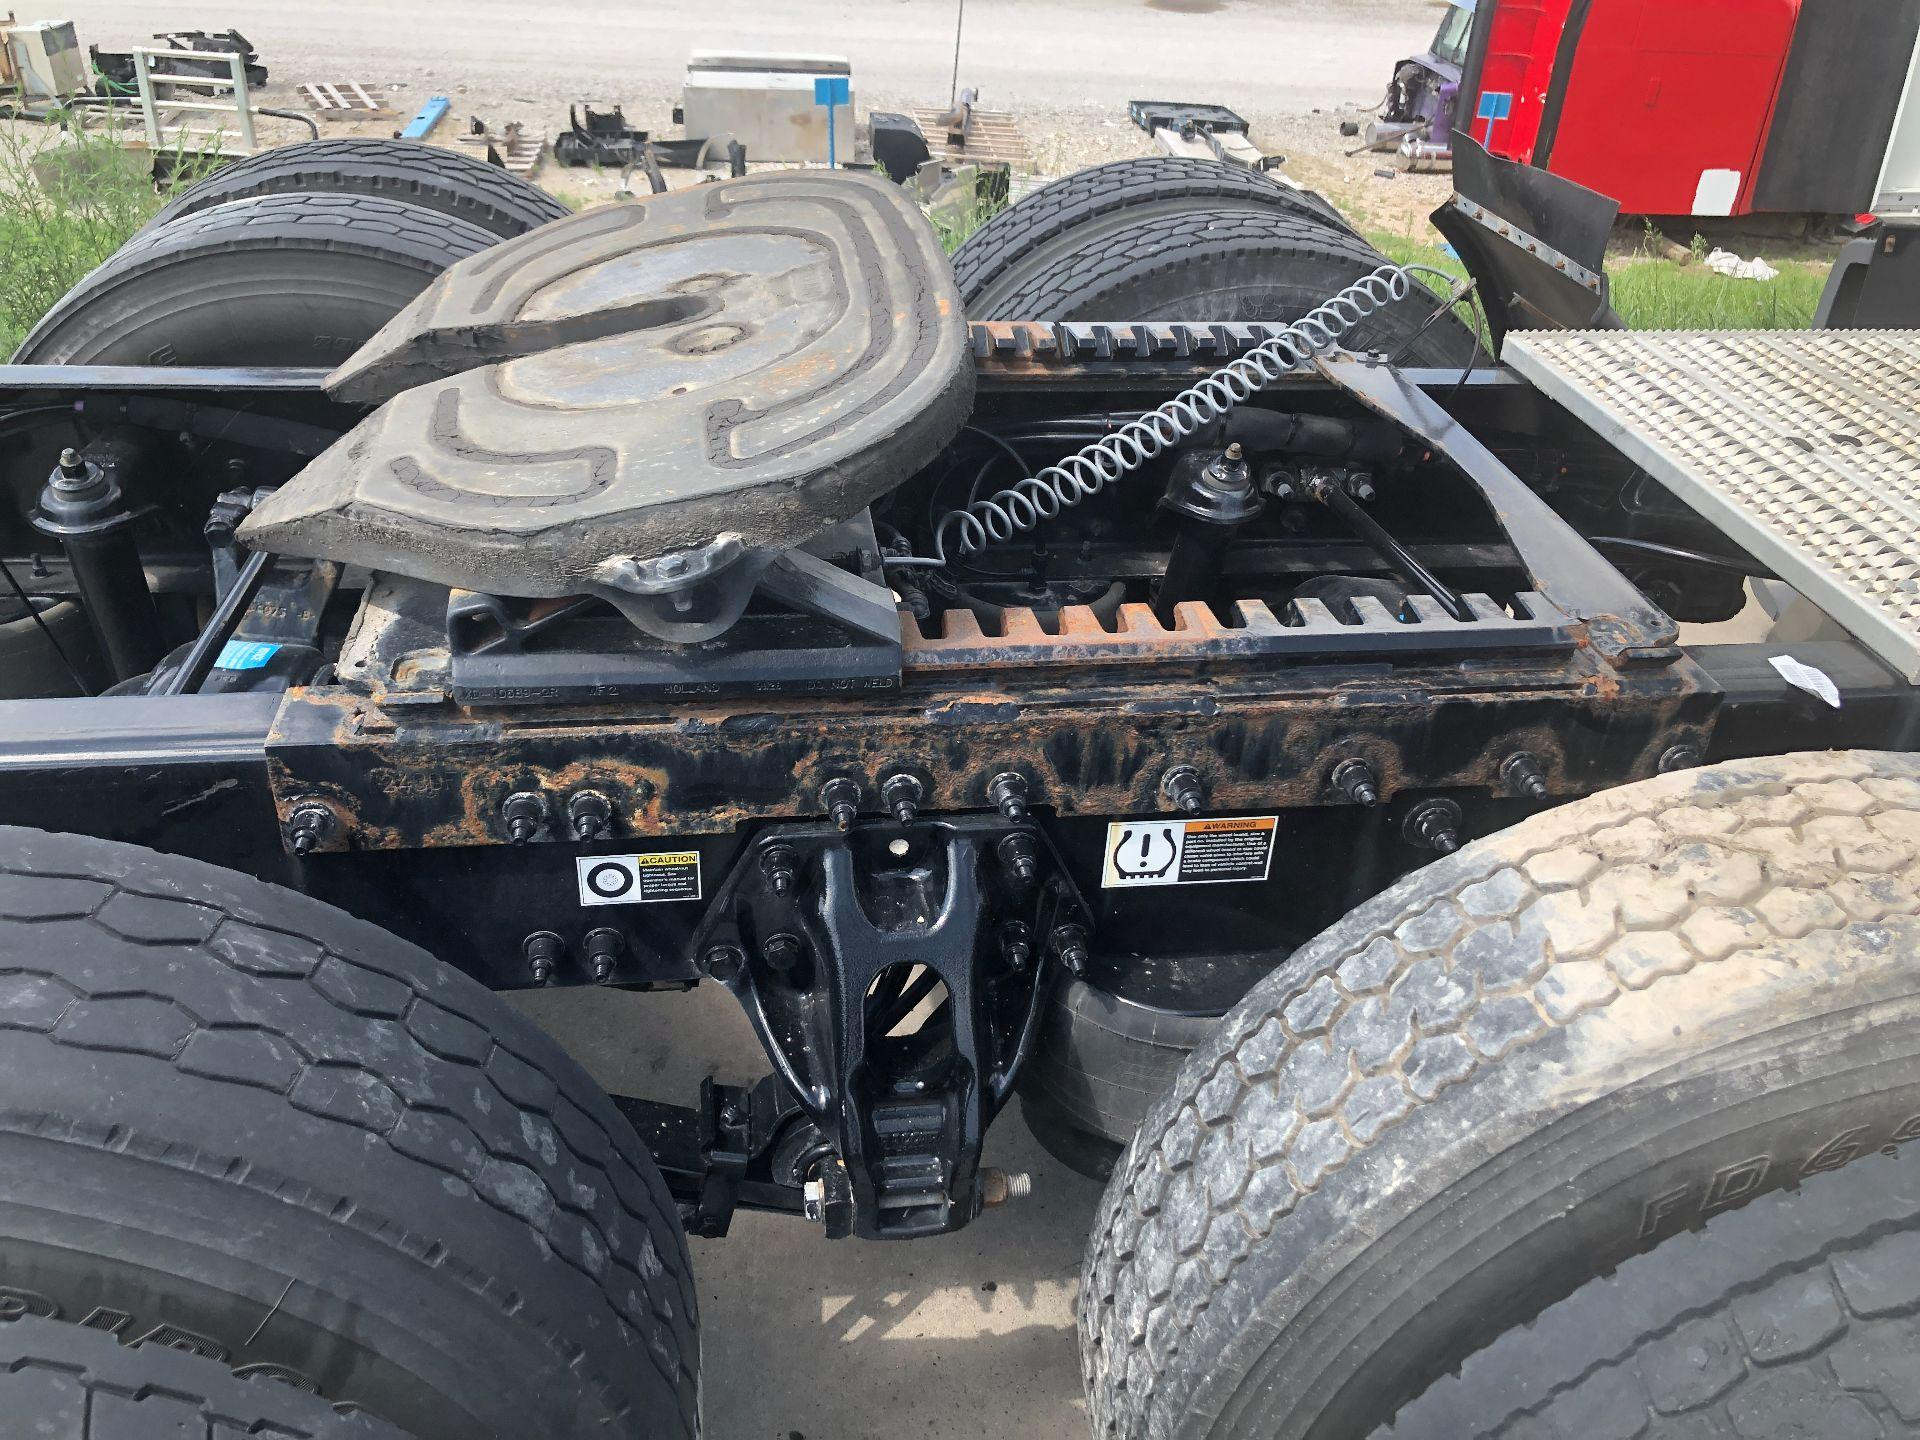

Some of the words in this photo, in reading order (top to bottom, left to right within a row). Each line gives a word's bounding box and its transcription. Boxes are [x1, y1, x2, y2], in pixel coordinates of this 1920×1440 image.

[664, 682, 720, 695] HOLLAND
[831, 678, 855, 690] NOT
[864, 677, 894, 689] WELD
